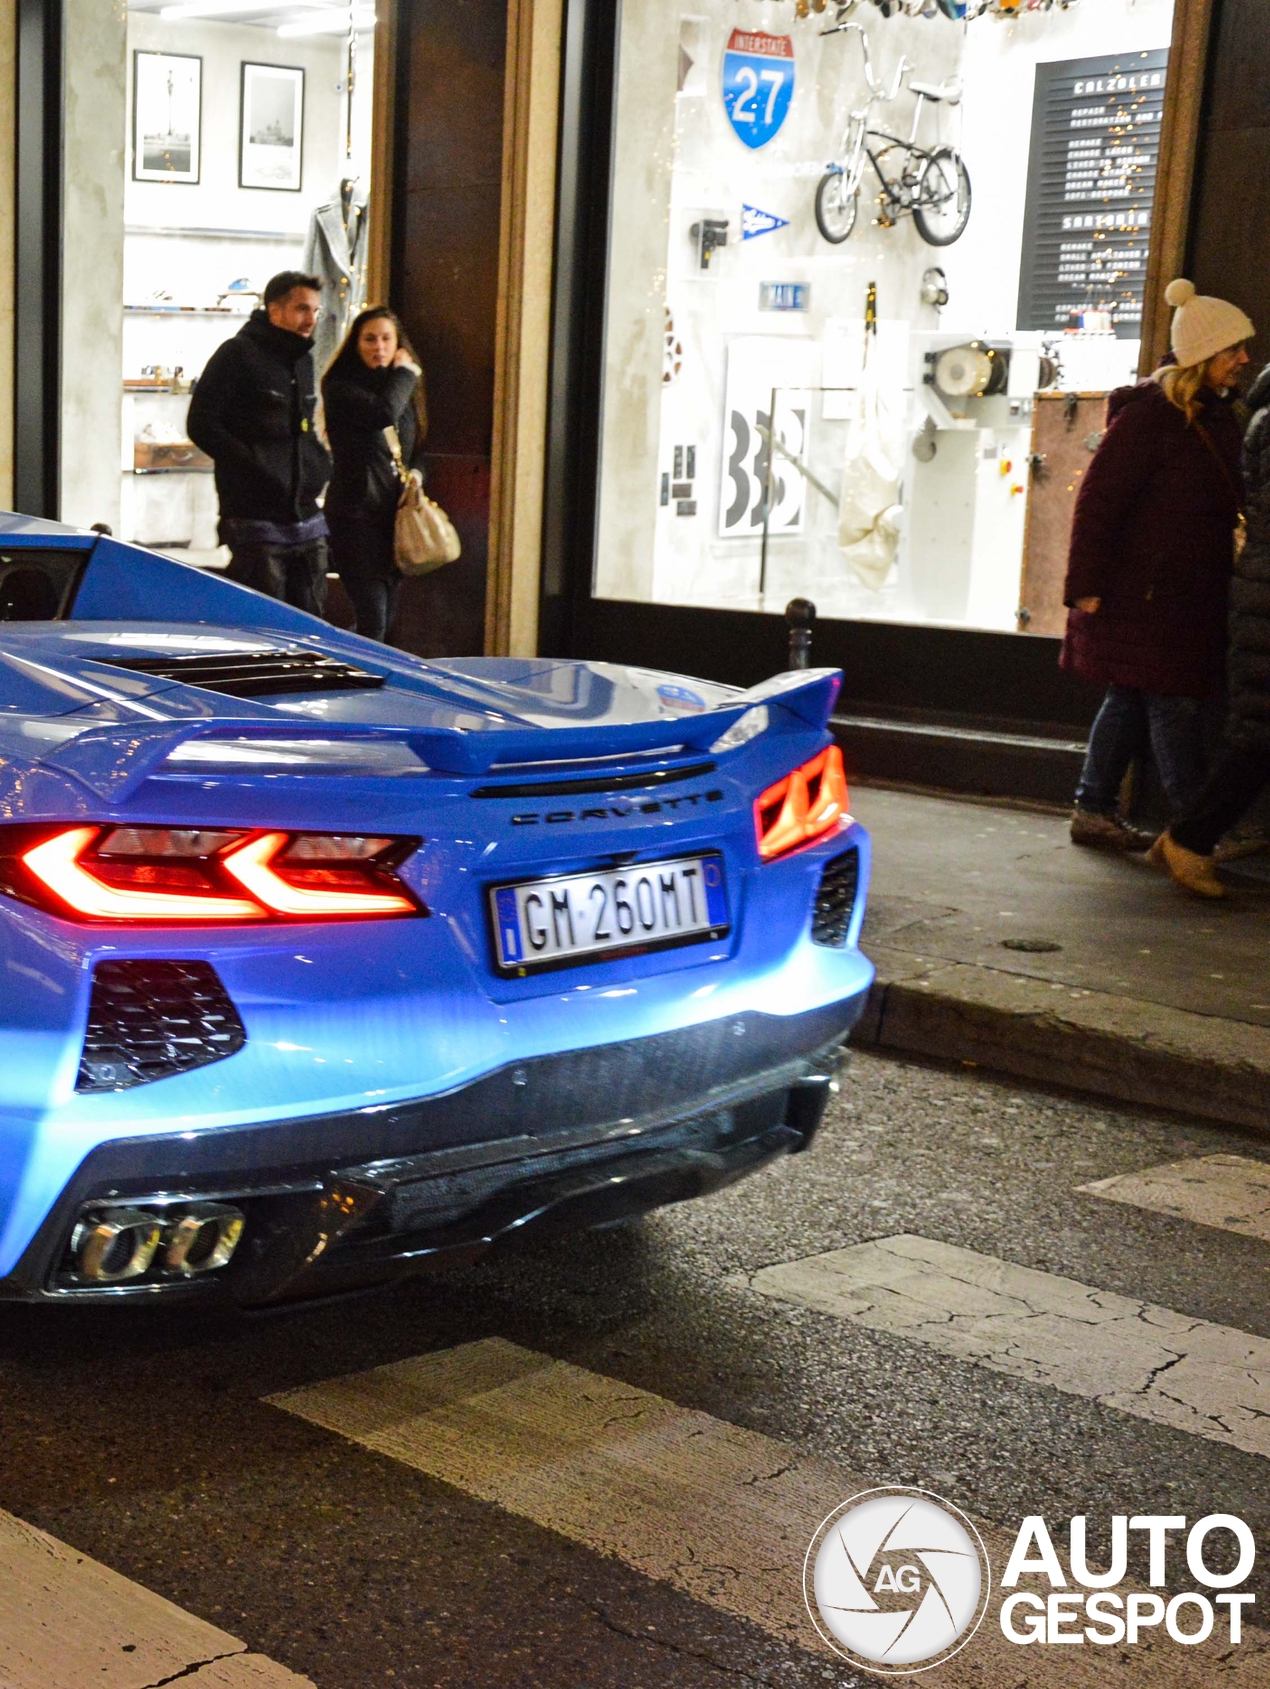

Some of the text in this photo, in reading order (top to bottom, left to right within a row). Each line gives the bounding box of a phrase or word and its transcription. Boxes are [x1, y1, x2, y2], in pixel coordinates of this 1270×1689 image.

[733, 34, 787, 56] INTERSTATE
[732, 66, 784, 124] 27
[511, 790, 724, 825] CORVETTE
[524, 888, 575, 950] GM
[589, 868, 697, 940] 260MT
